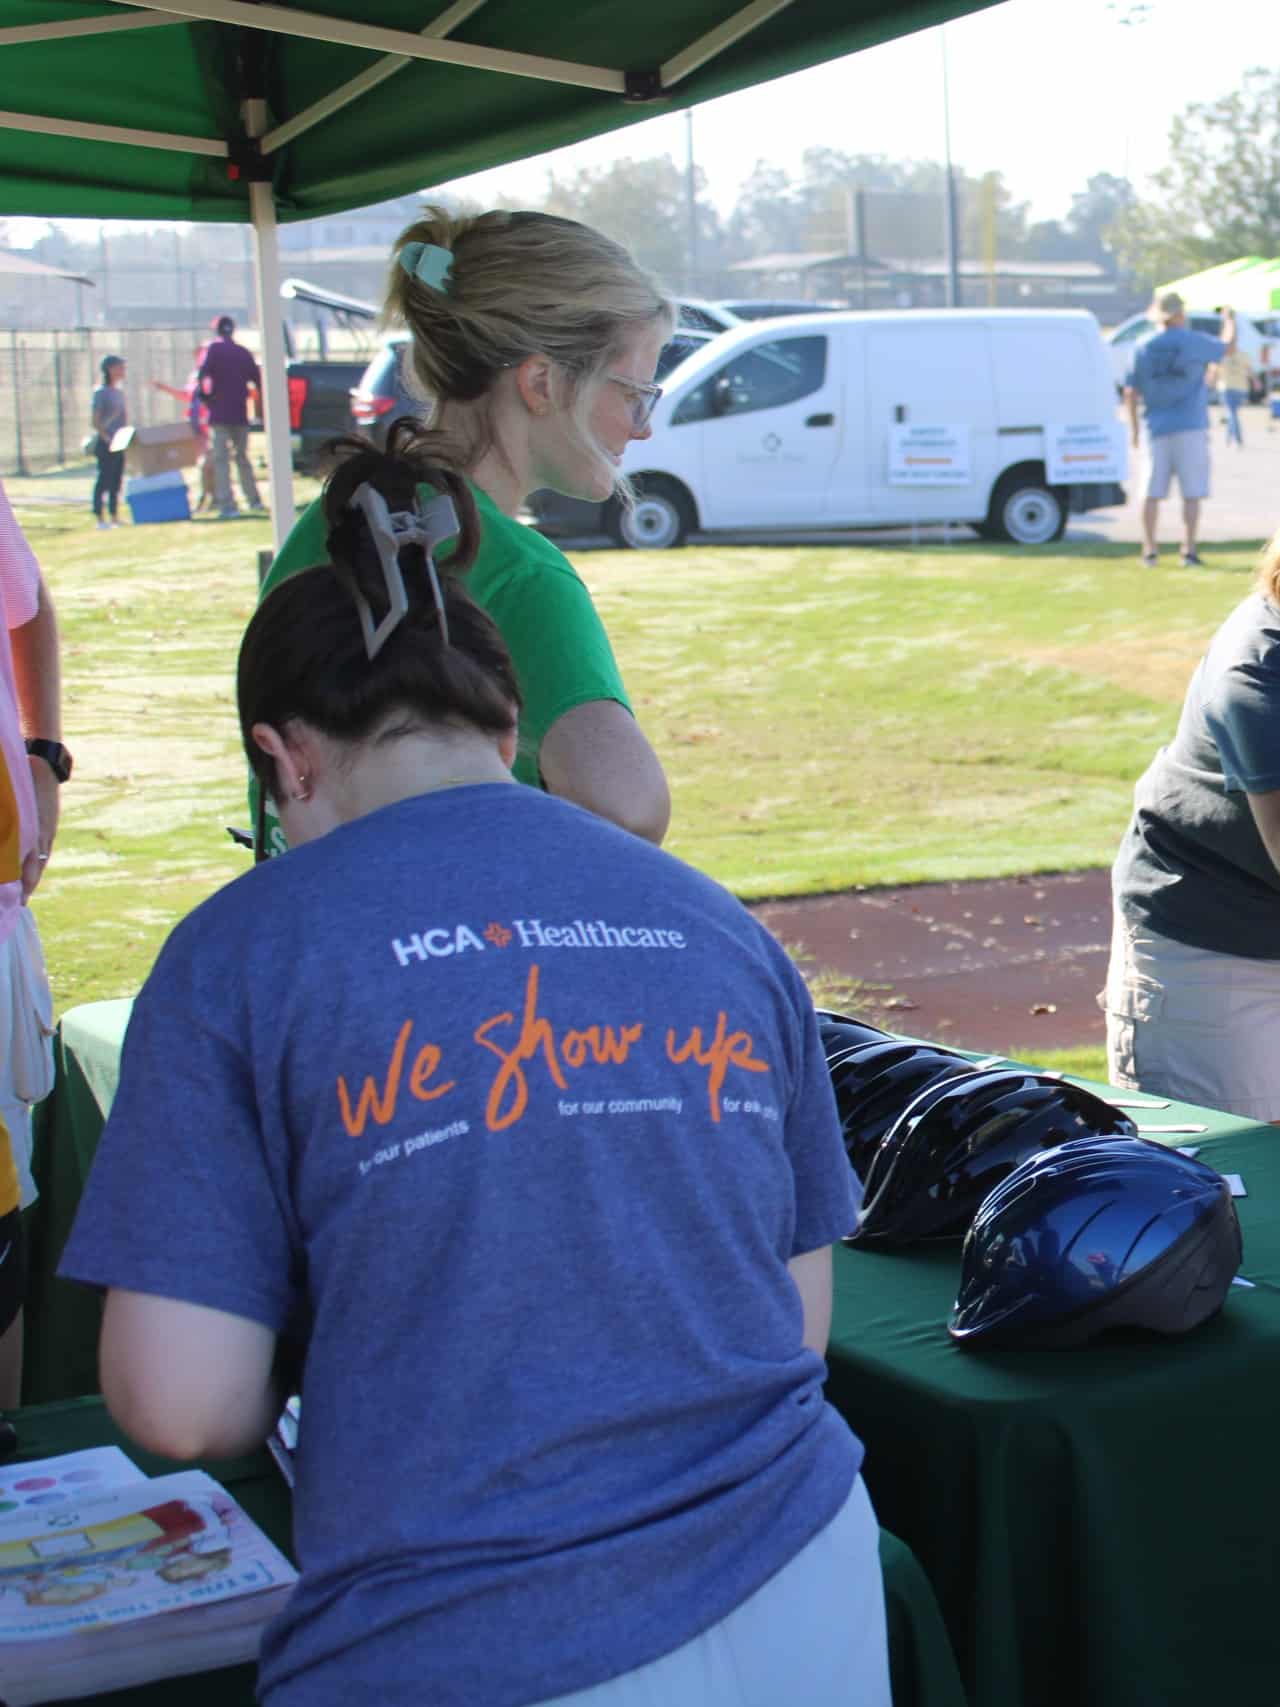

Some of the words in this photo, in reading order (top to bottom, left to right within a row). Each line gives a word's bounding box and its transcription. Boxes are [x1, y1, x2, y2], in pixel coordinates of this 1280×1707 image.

[392, 924, 485, 966] HCA
[514, 919, 687, 949] Healthcare
[337, 1019, 455, 1136] We
[666, 1011, 769, 1123] up
[557, 1101, 579, 1116] for
[582, 1100, 604, 1115] our
[607, 1097, 682, 1115] community
[722, 1097, 740, 1113] for
[373, 1144, 400, 1166] our
[404, 1120, 470, 1158] patients
